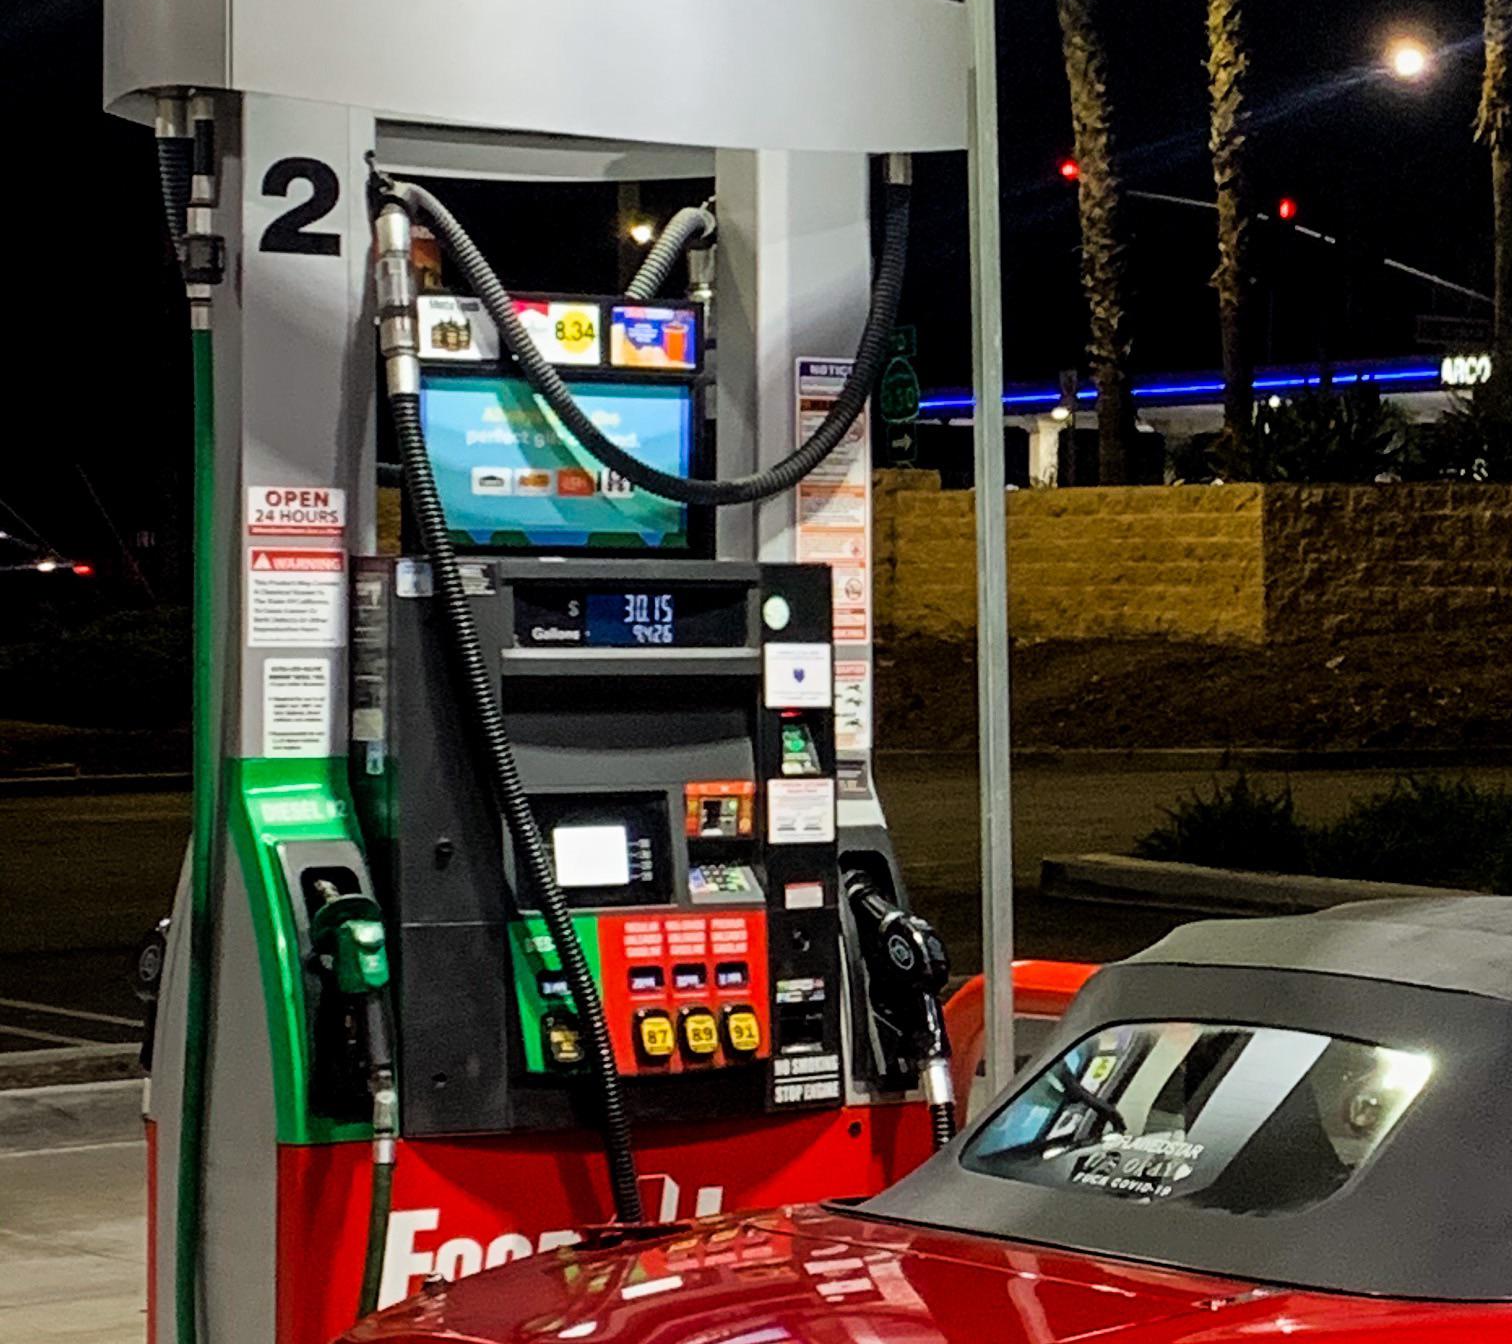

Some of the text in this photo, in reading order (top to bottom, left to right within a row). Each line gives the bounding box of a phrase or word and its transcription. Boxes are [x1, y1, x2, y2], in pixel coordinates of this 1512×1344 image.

[258, 156, 341, 257] 2
[555, 321, 596, 341] 8.34
[265, 490, 330, 507] OPEN
[255, 509, 339, 524] 24 HOURS
[531, 626, 582, 641] Gallons
[647, 1030, 668, 1044] 87
[691, 1027, 713, 1042] 89
[734, 1024, 756, 1039] 91
[775, 1085, 803, 1103] STOP
[1110, 1177, 1172, 1197] COVID-19
